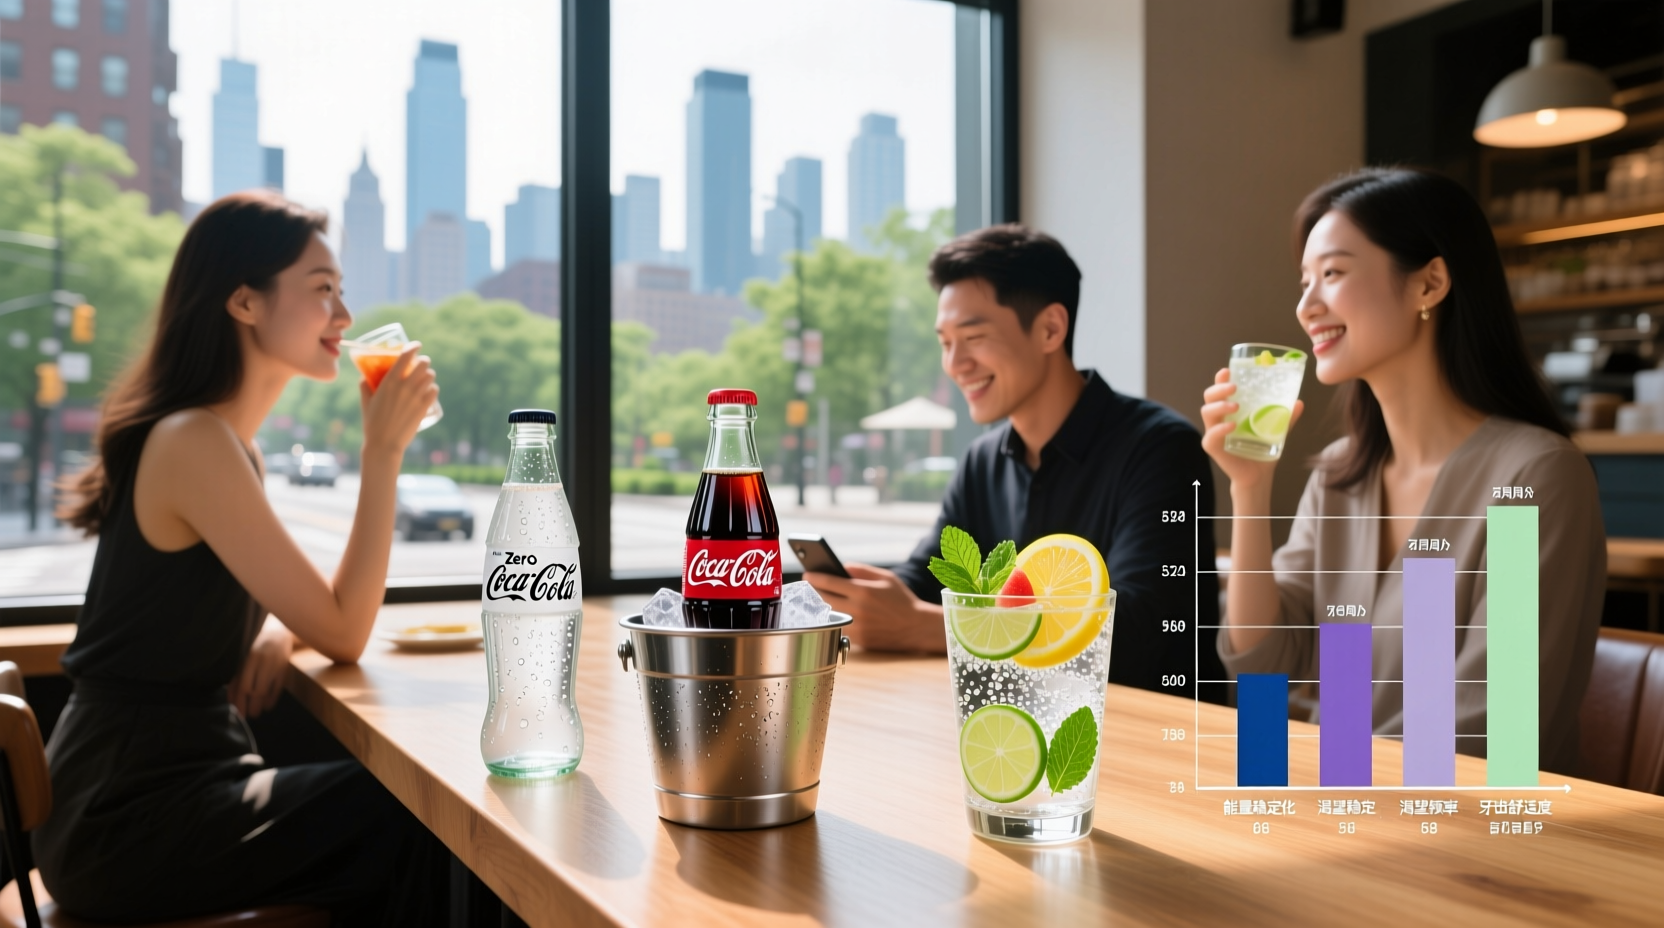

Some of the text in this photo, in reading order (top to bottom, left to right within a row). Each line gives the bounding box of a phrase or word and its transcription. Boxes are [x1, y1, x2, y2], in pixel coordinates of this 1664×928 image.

[504, 551, 538, 566] Zero
[688, 548, 779, 587] Coca-Cola
[486, 562, 578, 602] Coca-Cola
